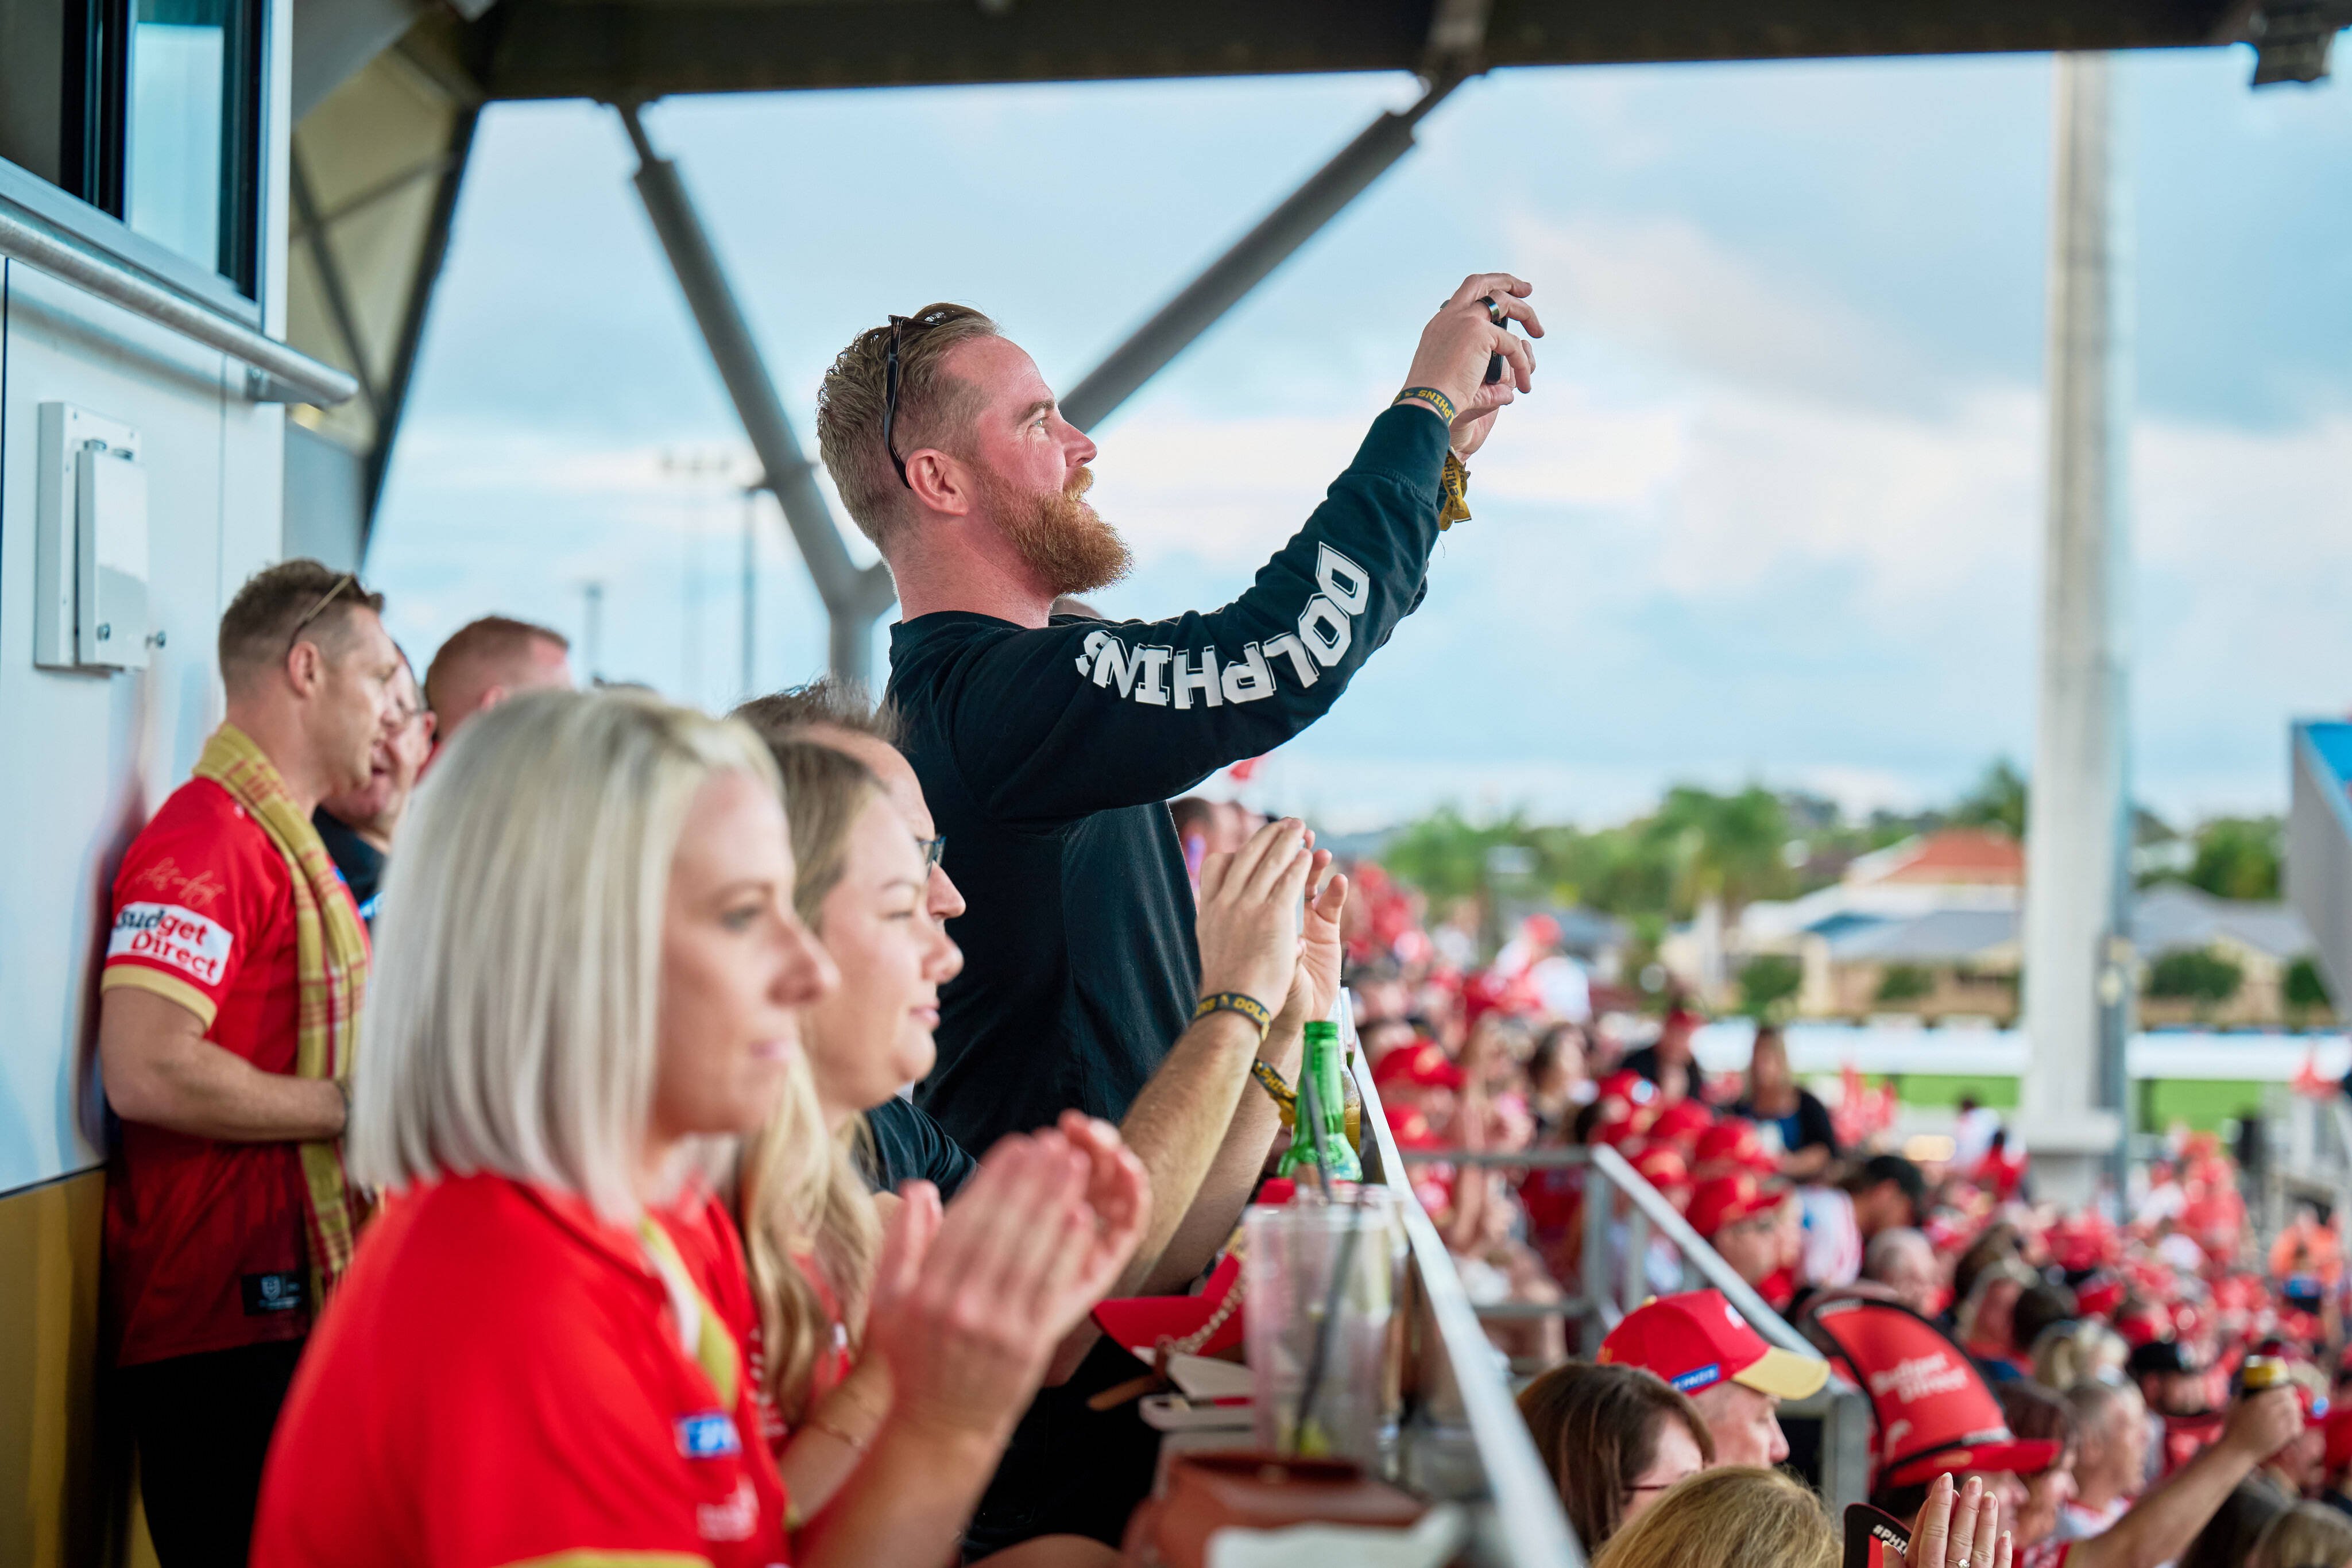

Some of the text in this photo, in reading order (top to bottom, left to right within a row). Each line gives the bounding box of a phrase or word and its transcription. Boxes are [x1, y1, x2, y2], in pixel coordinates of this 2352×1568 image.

[1075, 541, 1370, 710] DOLPHINS
[130, 931, 217, 978] Direct
[1873, 1524, 1908, 1555] #PHI
